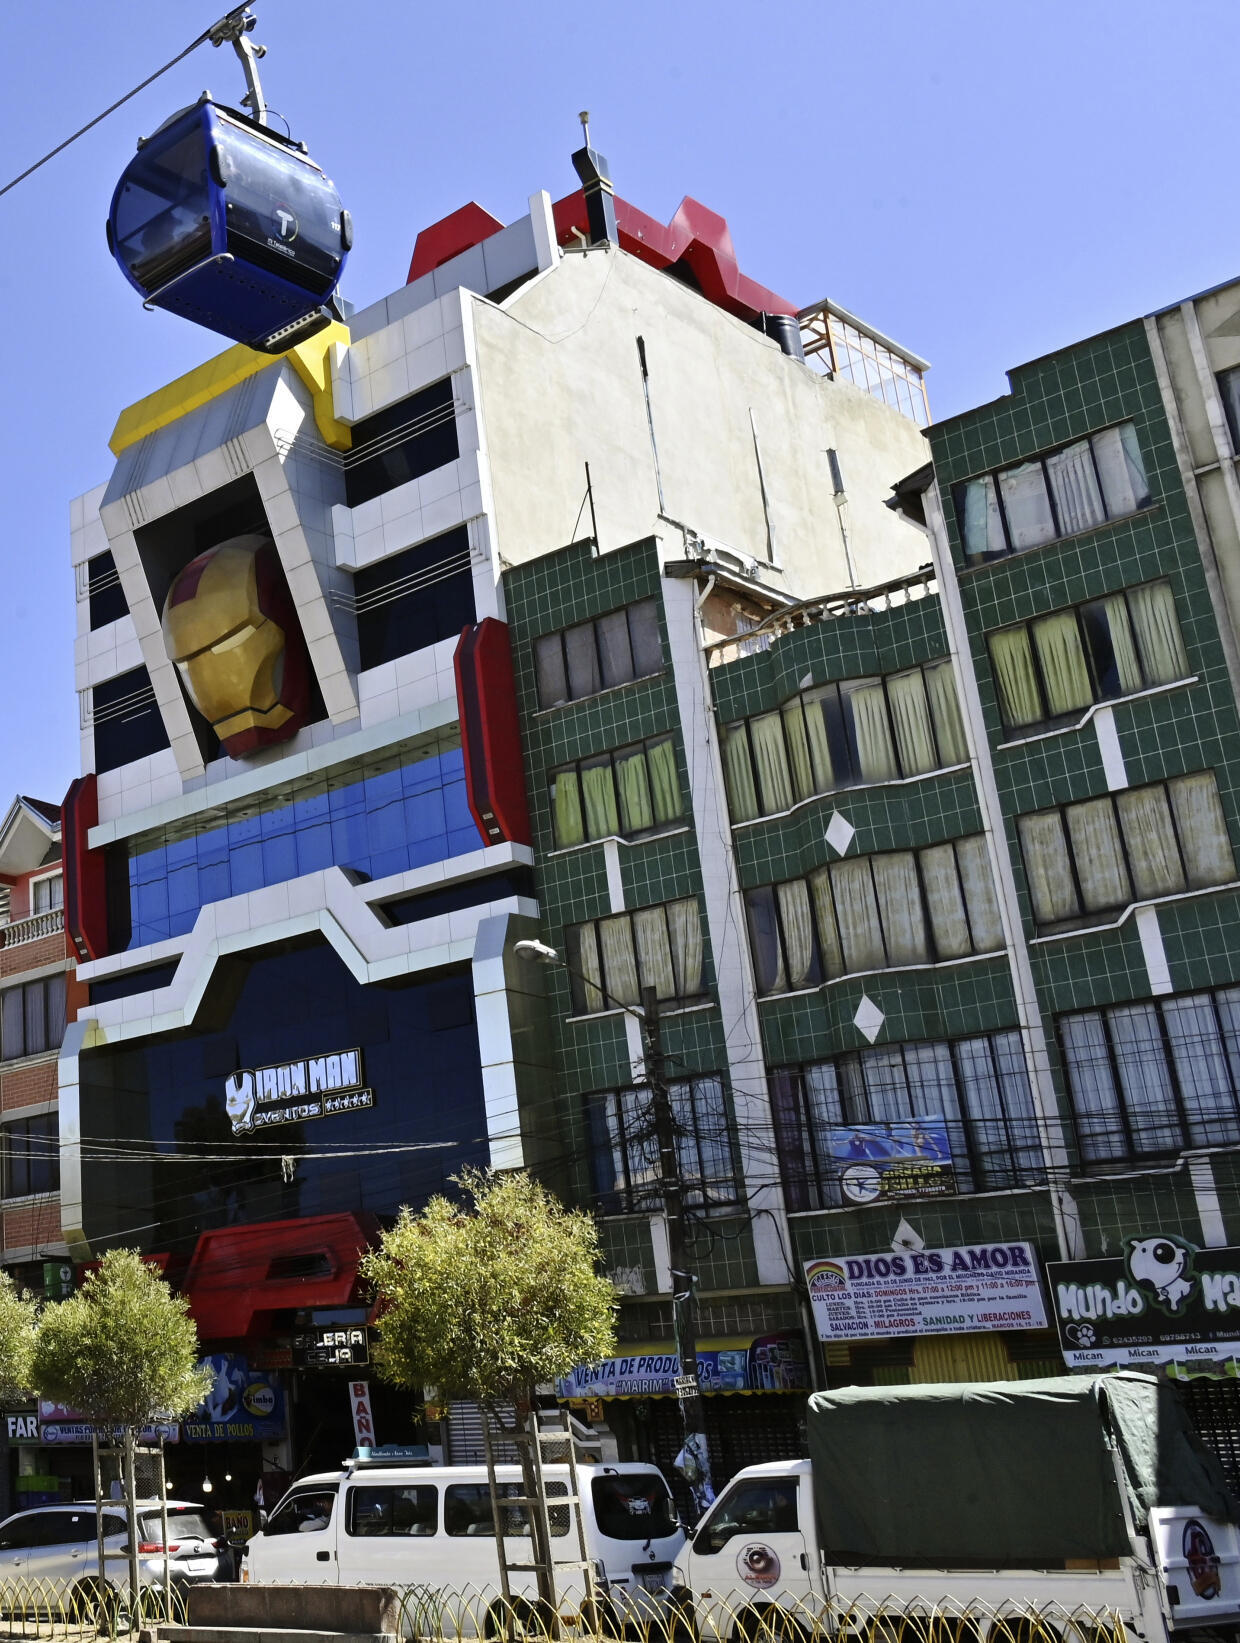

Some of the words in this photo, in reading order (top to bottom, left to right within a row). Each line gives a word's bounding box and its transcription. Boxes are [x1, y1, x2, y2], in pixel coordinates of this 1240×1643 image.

[256, 1062, 308, 1103] IRON
[309, 1050, 359, 1093] MAN
[255, 1103, 321, 1126] EVENTOS
[846, 1256, 906, 1280] DIOS
[911, 1252, 944, 1274] ES
[951, 1246, 1031, 1271] AMOR
[811, 1293, 835, 1301] CULTO
[853, 1290, 872, 1298] DIAS:
[874, 1288, 906, 1297] DOMINGOS
[922, 1285, 939, 1293] 07:00
[946, 1283, 962, 1292] 12:00
[981, 1281, 998, 1289] 11:00
[1057, 1281, 1143, 1320] Mundo
[829, 1321, 868, 1331] SALVACION
[874, 1317, 914, 1328] MILAGROS
[922, 1314, 964, 1325] SANIDAD
[968, 1314, 974, 1322] Y
[976, 1310, 1030, 1322] LIBERACIONES
[1073, 1352, 1103, 1361] Mican
[1128, 1348, 1159, 1358] Mican
[1185, 1345, 1218, 1355] Mican
[575, 1362, 617, 1387] VENTA
[620, 1358, 635, 1375] DE
[637, 1356, 713, 1382] PRODUOS
[186, 1425, 211, 1438] VENTA
[214, 1424, 225, 1437] DE
[227, 1424, 254, 1437] POLLOS
[226, 1512, 249, 1529] BAÑO
